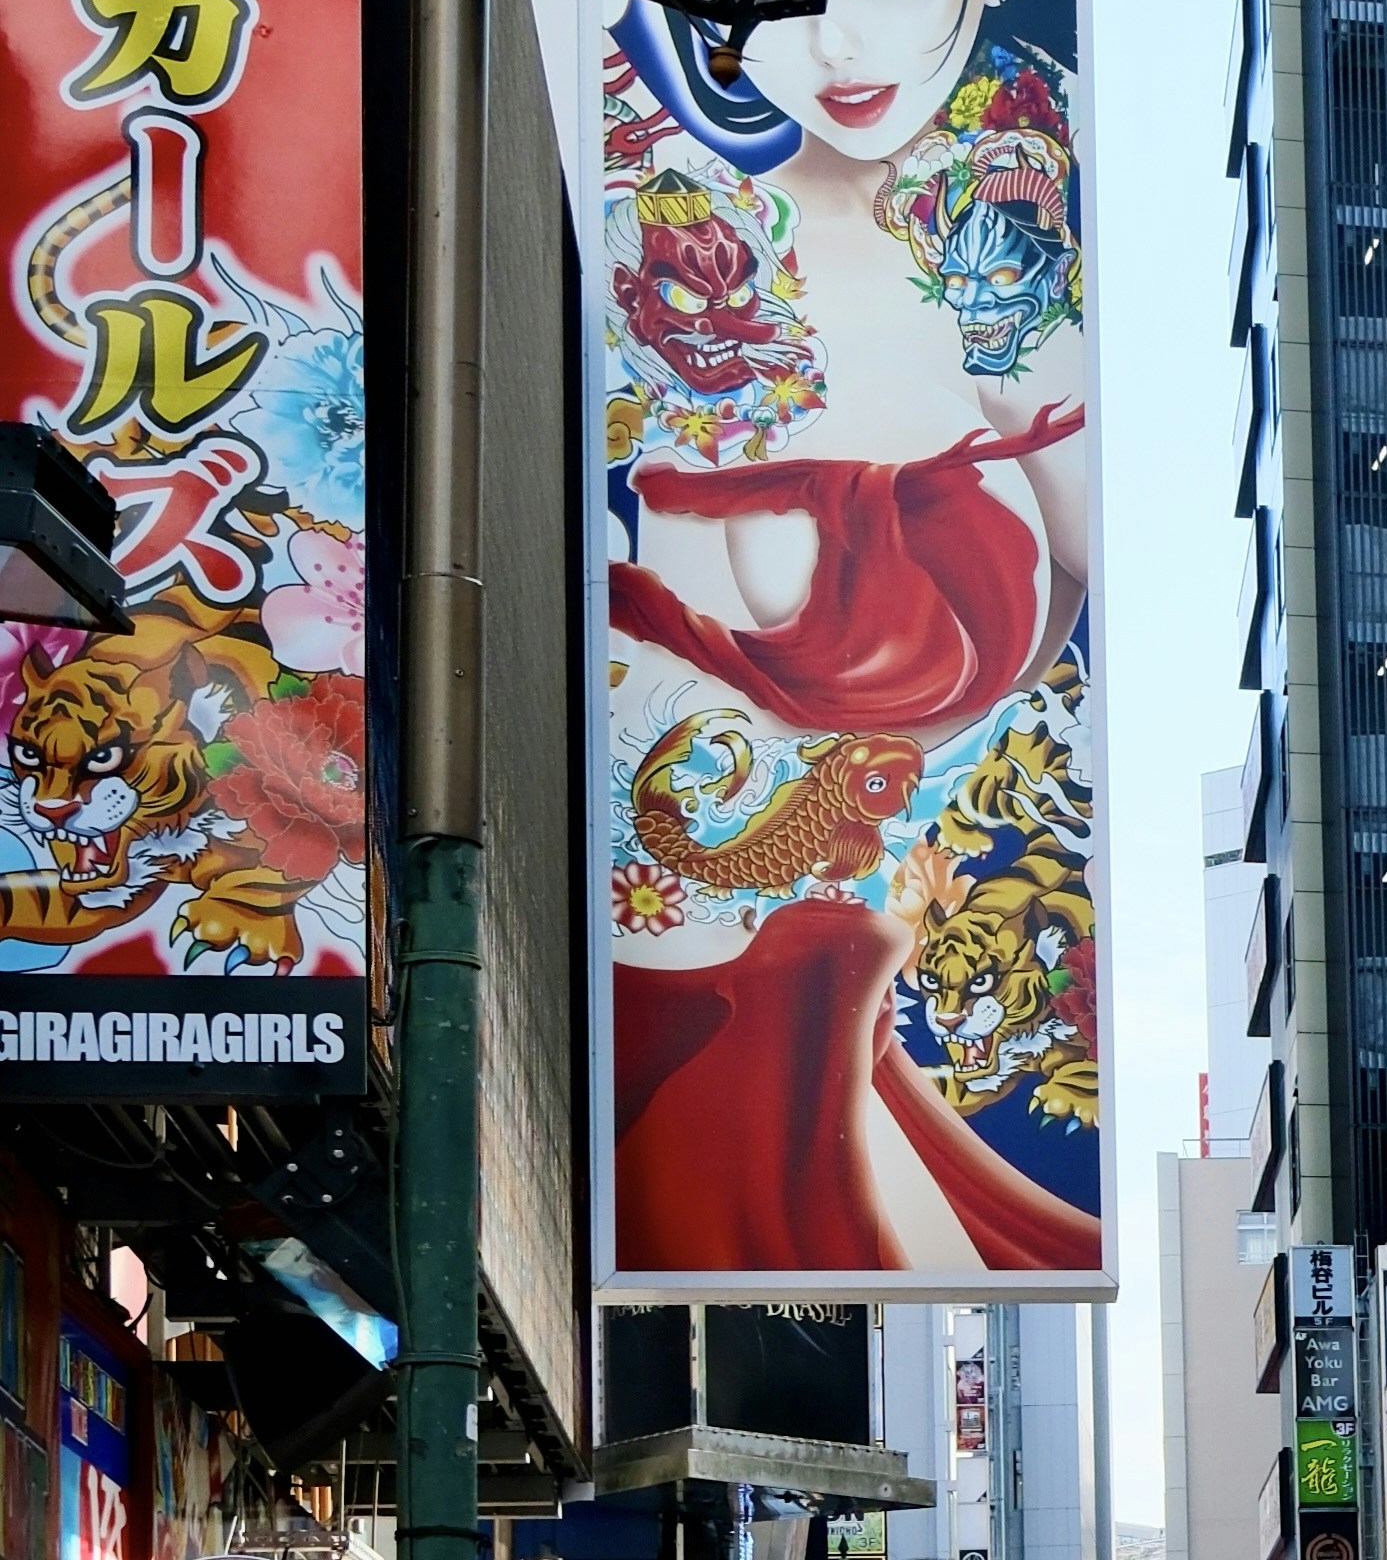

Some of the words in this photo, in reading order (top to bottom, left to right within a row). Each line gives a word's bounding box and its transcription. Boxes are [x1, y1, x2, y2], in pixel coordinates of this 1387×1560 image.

[1309, 1249, 1333, 1316] 梅谷ビル
[1305, 1338, 1340, 1351] Awa
[1304, 1356, 1343, 1370] Yoku
[1311, 1374, 1338, 1387] Bar
[1301, 1395, 1348, 1412] AMG
[1335, 1422, 1354, 1434] 3F
